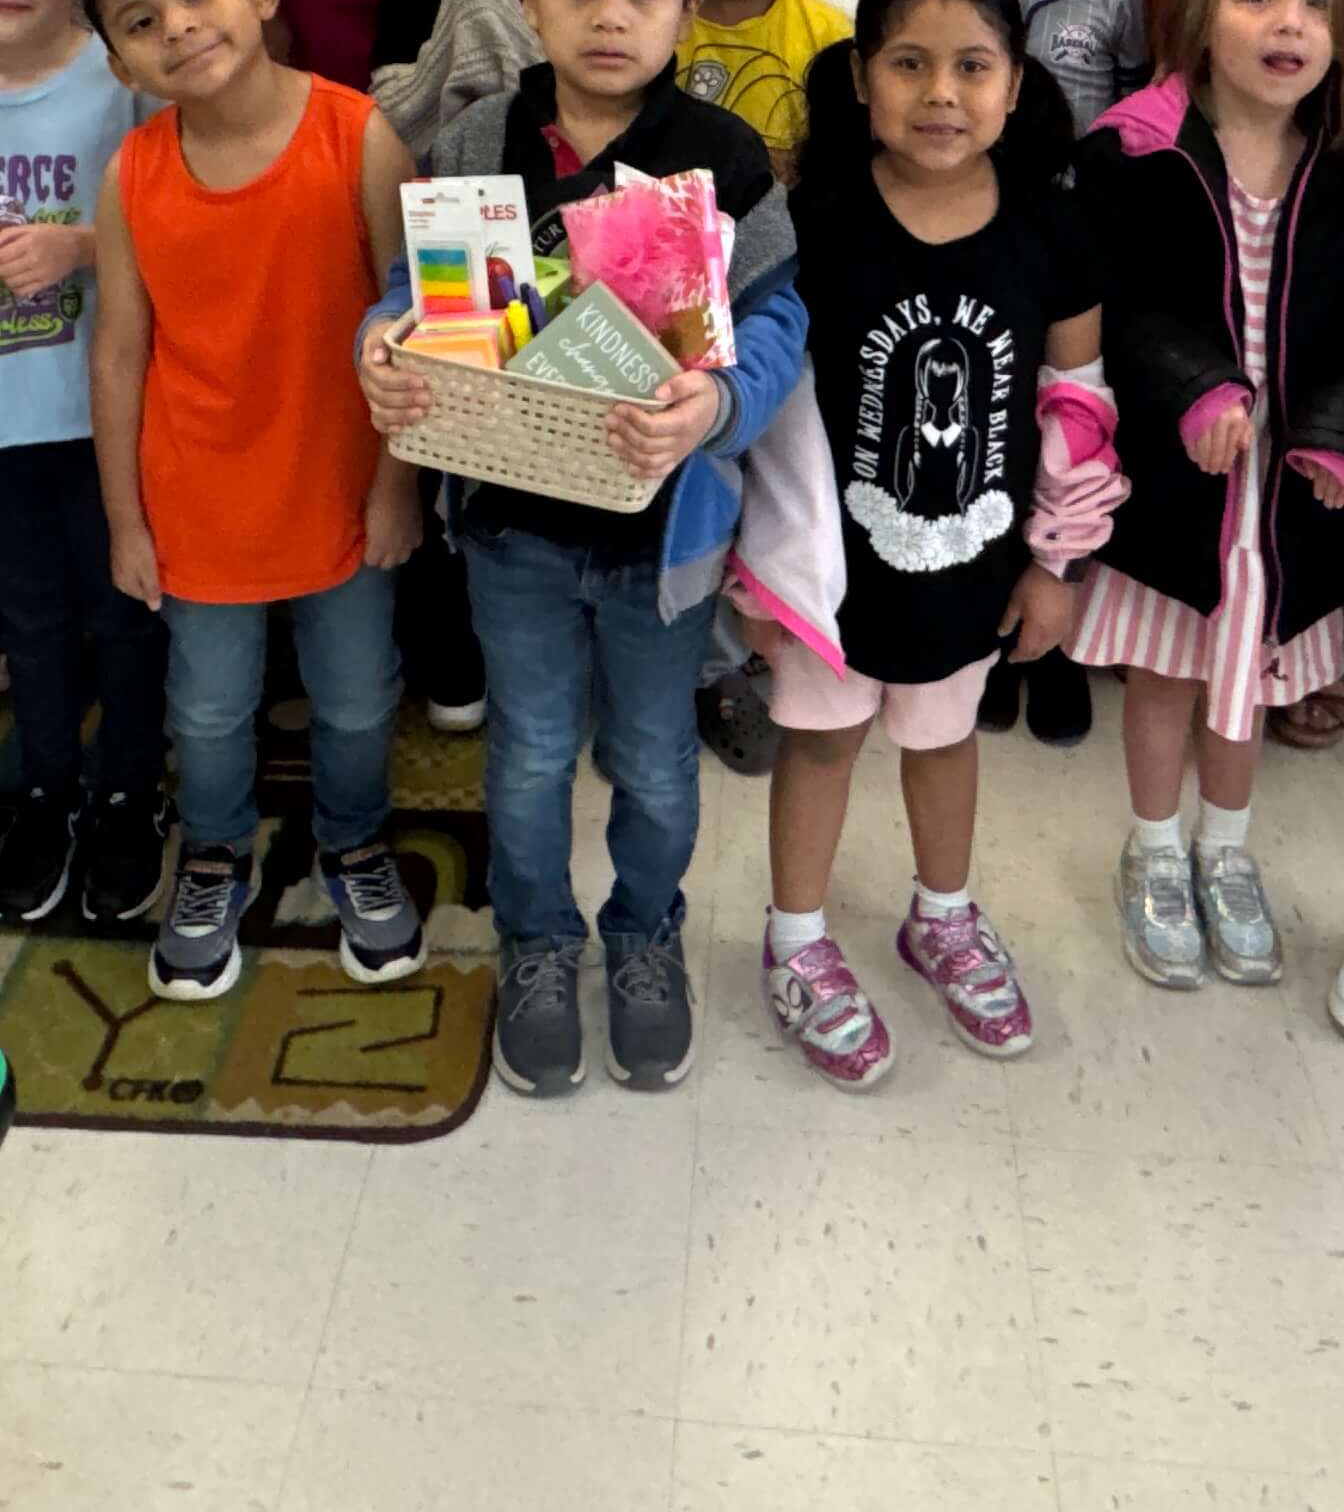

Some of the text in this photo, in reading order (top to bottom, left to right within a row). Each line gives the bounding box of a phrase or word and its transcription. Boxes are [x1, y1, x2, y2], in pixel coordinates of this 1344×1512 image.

[575, 302, 660, 394] KINDNESS
[852, 294, 1016, 485] ON WEDNESDAYS, WE WEAR BLACK
